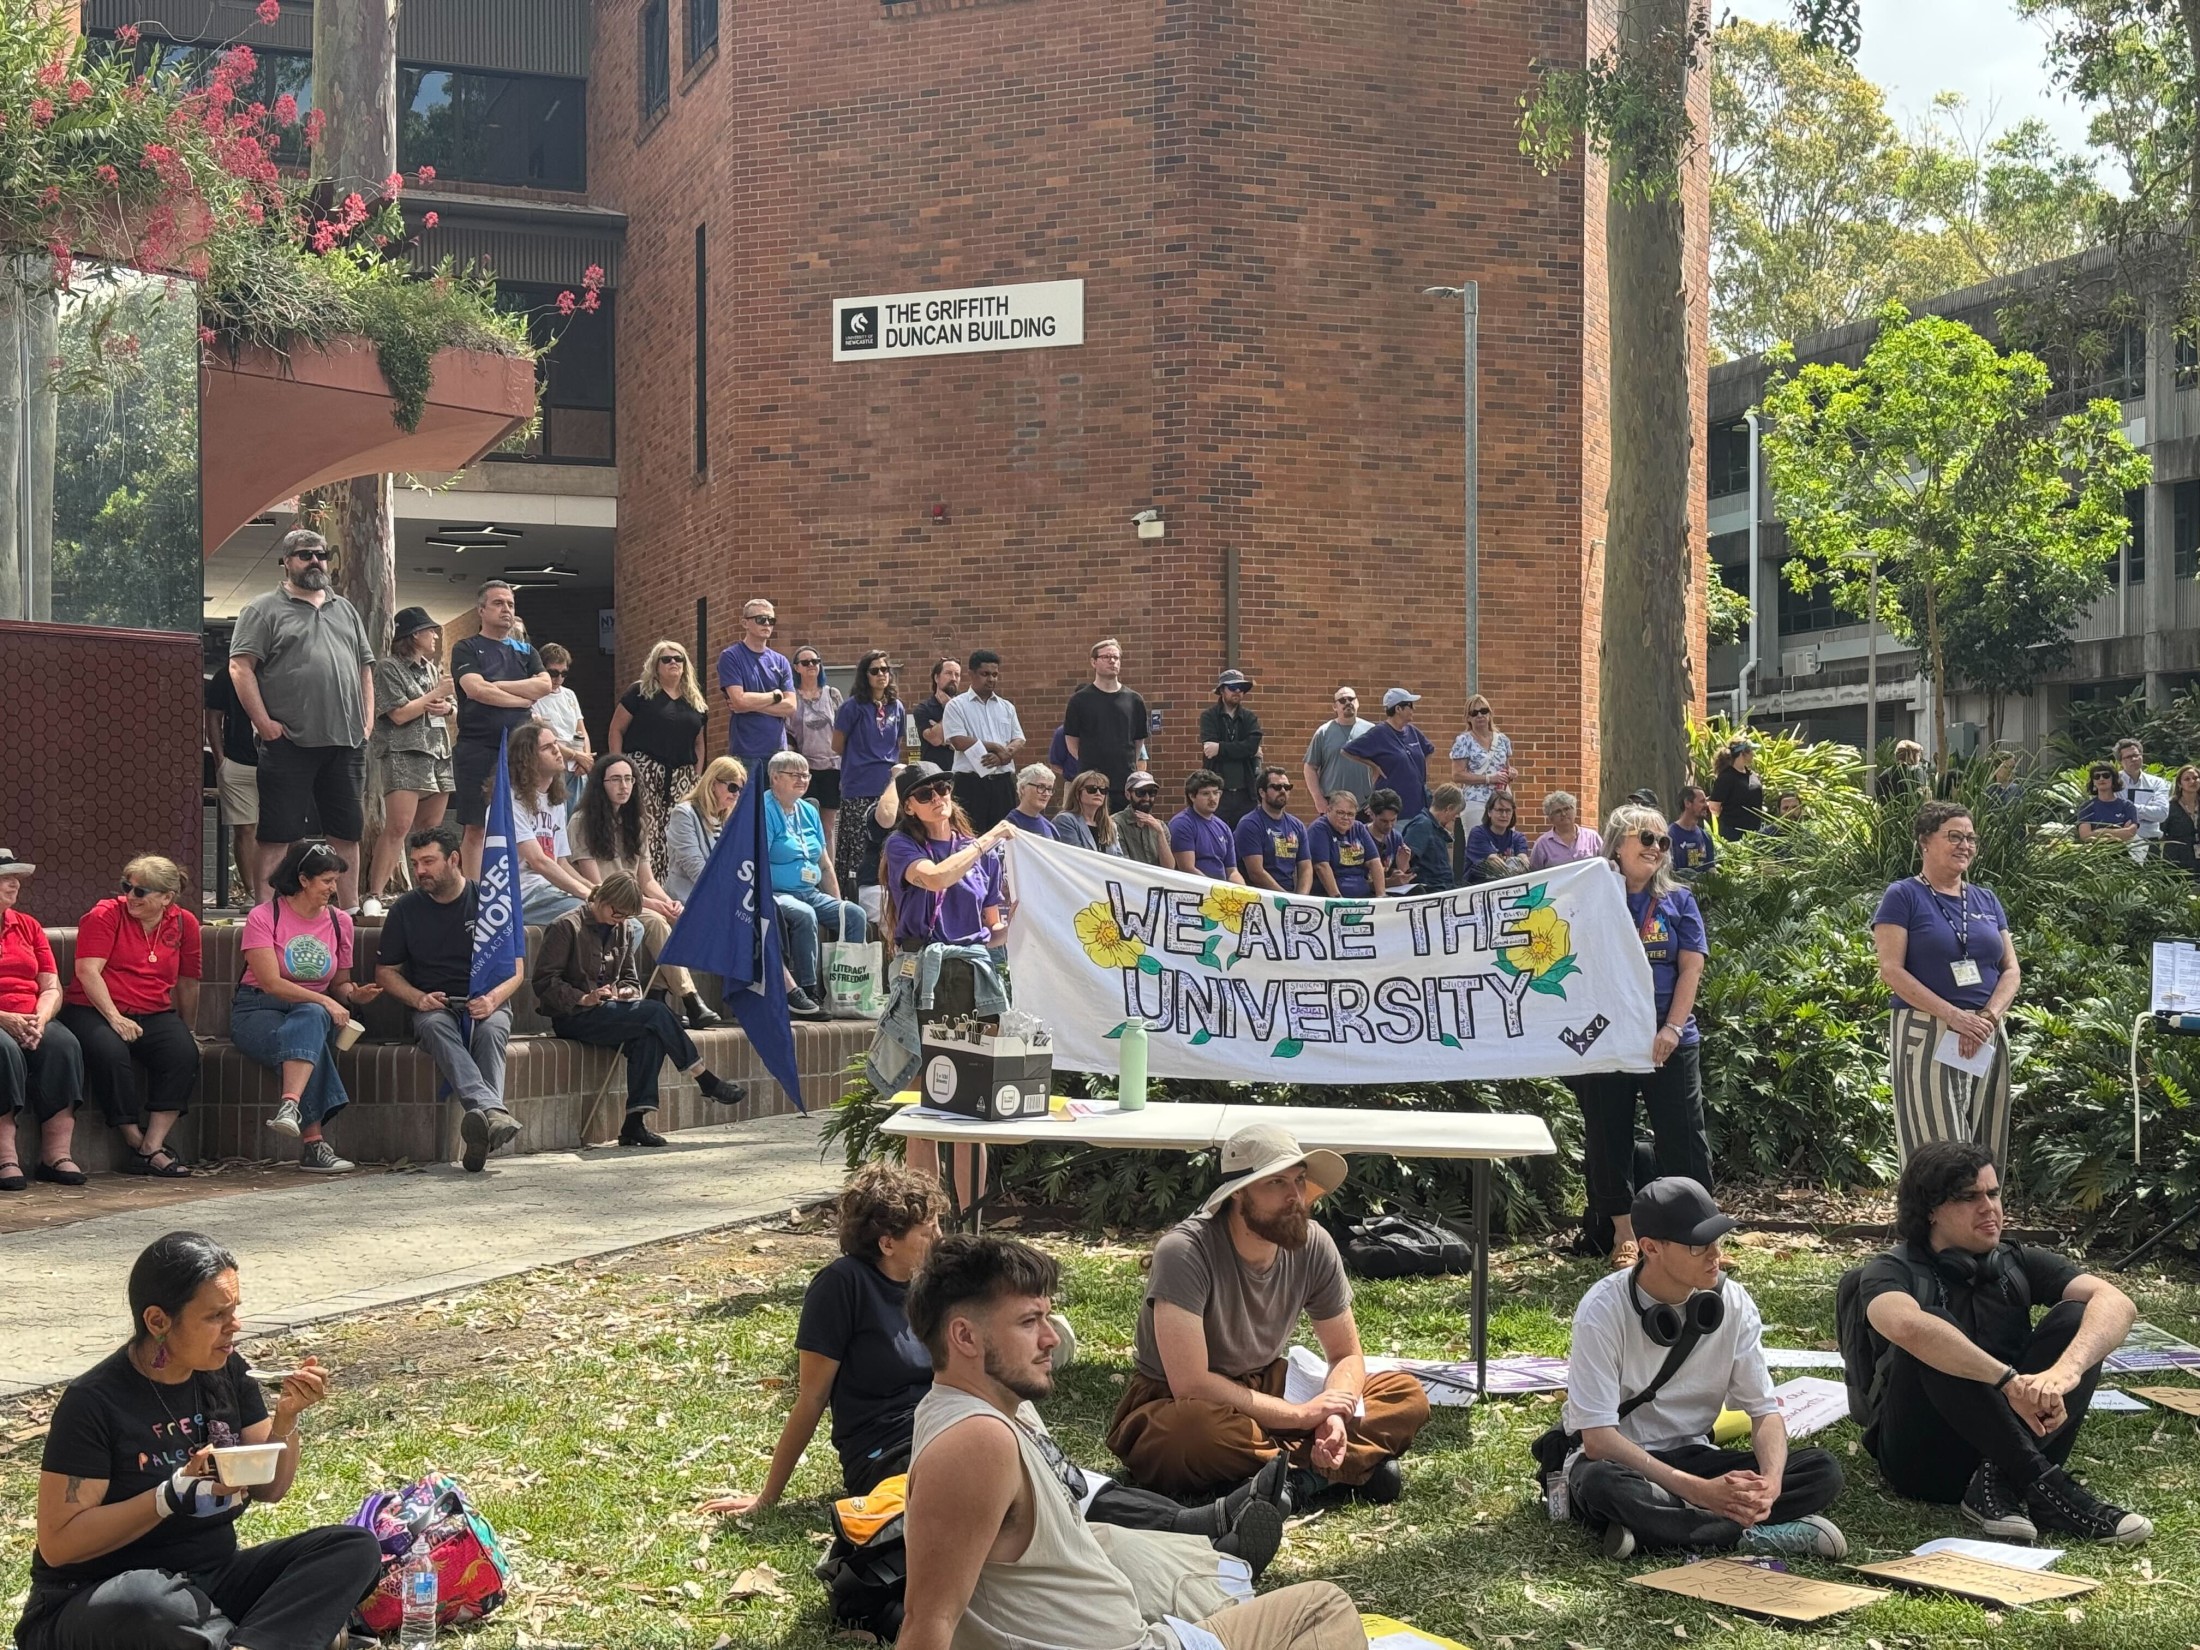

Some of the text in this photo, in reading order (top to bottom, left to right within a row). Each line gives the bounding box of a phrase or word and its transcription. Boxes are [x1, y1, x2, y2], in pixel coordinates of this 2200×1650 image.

[885, 295, 1009, 325] THE GRIFFITH
[885, 316, 1056, 348] DUNCAN BUILDING
[1105, 880, 1206, 956] WE
[1236, 902, 1377, 961] ARE
[1396, 882, 1533, 957] THE
[1643, 932, 1669, 943] ACES
[469, 958, 486, 978] NSW
[829, 972, 870, 984] IS FREEDOM
[832, 963, 867, 975] LITERACY
[1123, 967, 1535, 1044] UNIVERSITY
[1563, 1018, 1605, 1053] NTEU
